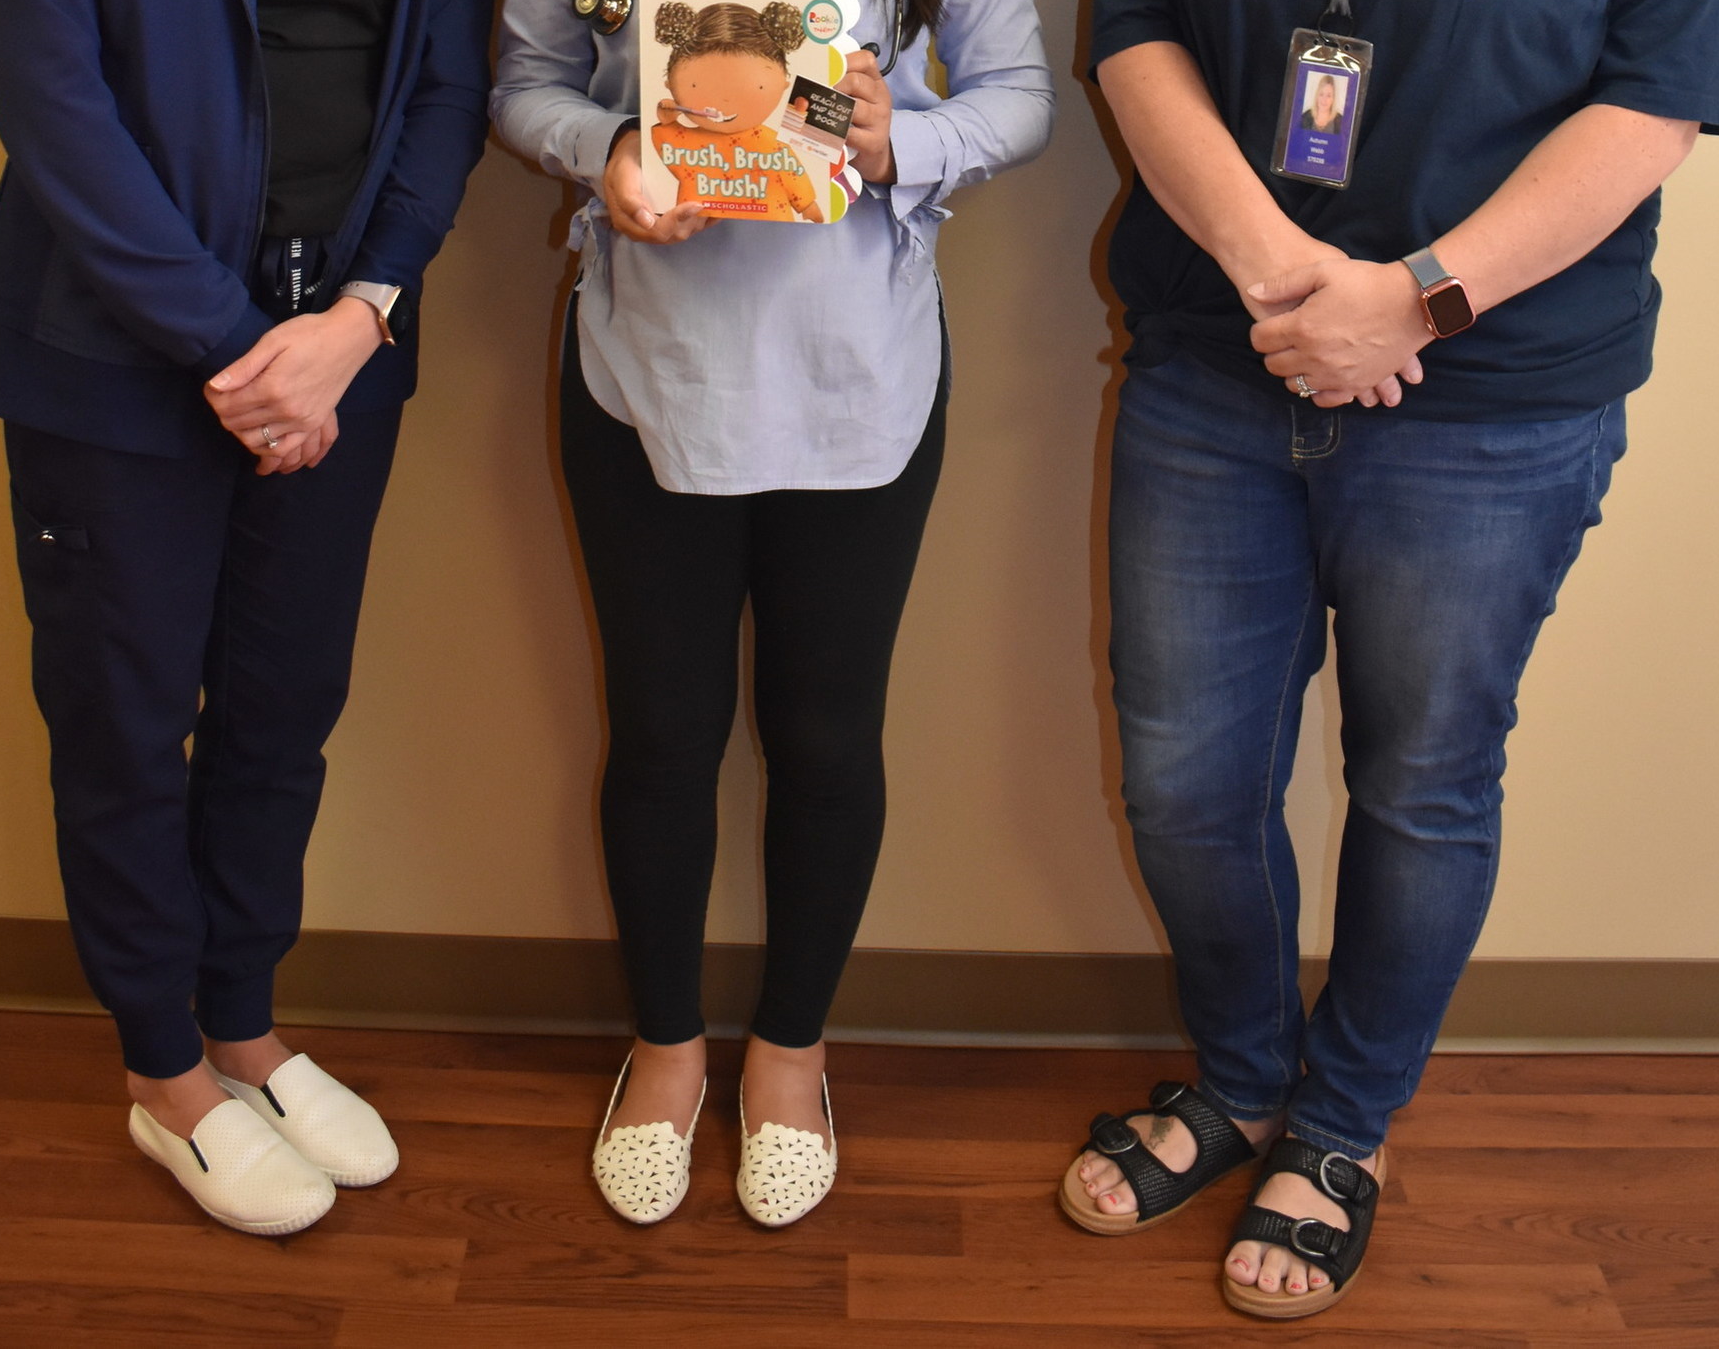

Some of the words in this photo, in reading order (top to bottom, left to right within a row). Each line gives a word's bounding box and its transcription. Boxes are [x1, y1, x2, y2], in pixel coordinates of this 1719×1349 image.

[836, 104, 852, 115] OUT
[662, 143, 730, 171] Brush,
[734, 146, 804, 175] Brush,
[696, 173, 768, 198] Brush!
[711, 202, 767, 212] SCHOLASTIC
